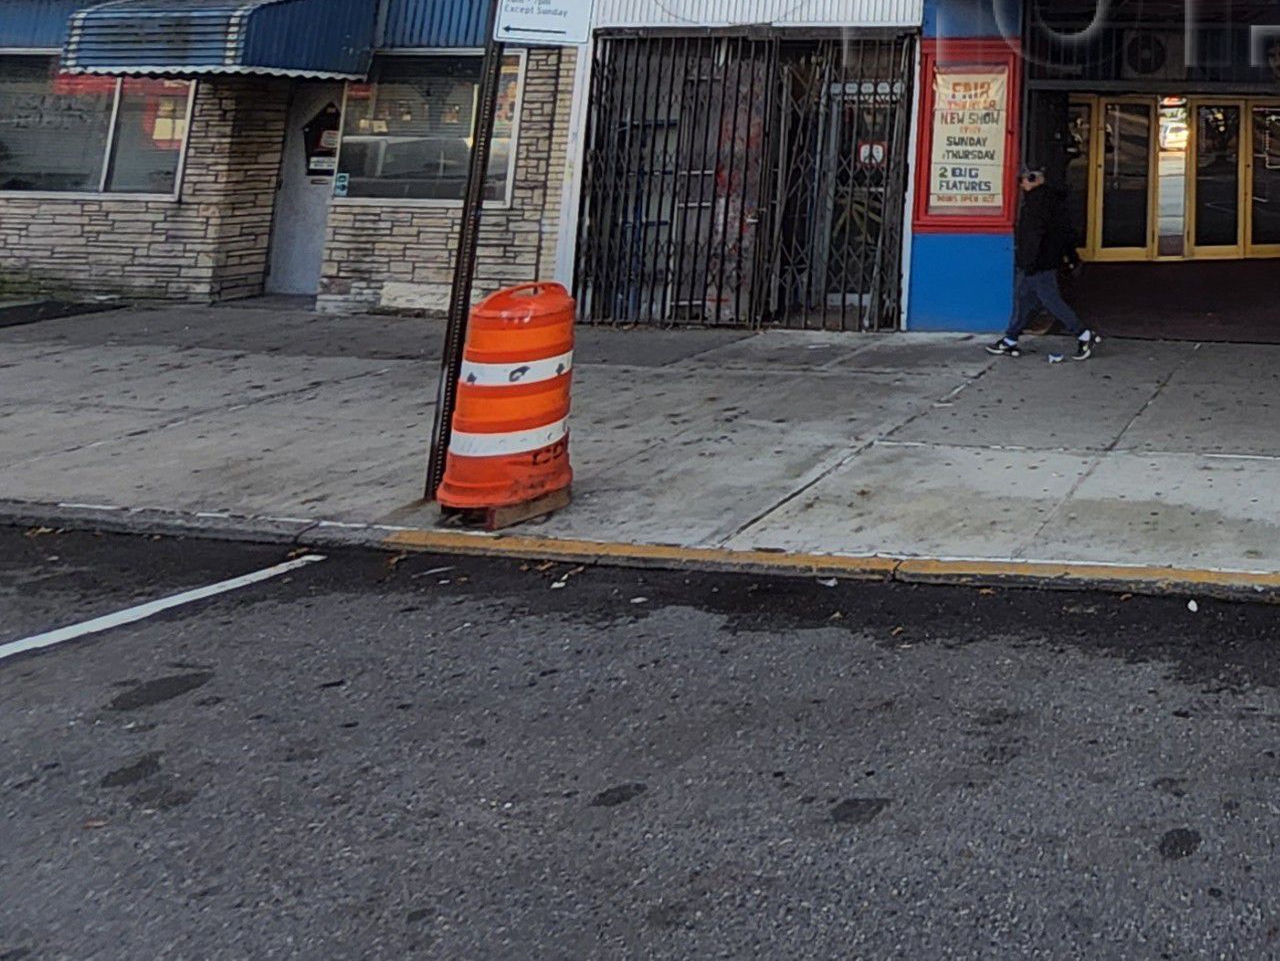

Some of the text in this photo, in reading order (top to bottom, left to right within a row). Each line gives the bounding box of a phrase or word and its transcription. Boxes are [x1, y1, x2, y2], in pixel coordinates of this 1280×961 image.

[505, 5, 568, 17] Except Sunday
[941, 110, 1000, 125] NEW SHOW
[946, 136, 987, 147] SUNDAY
[939, 167, 979, 178] 2 BIG
[939, 181, 991, 191] FEATURES
